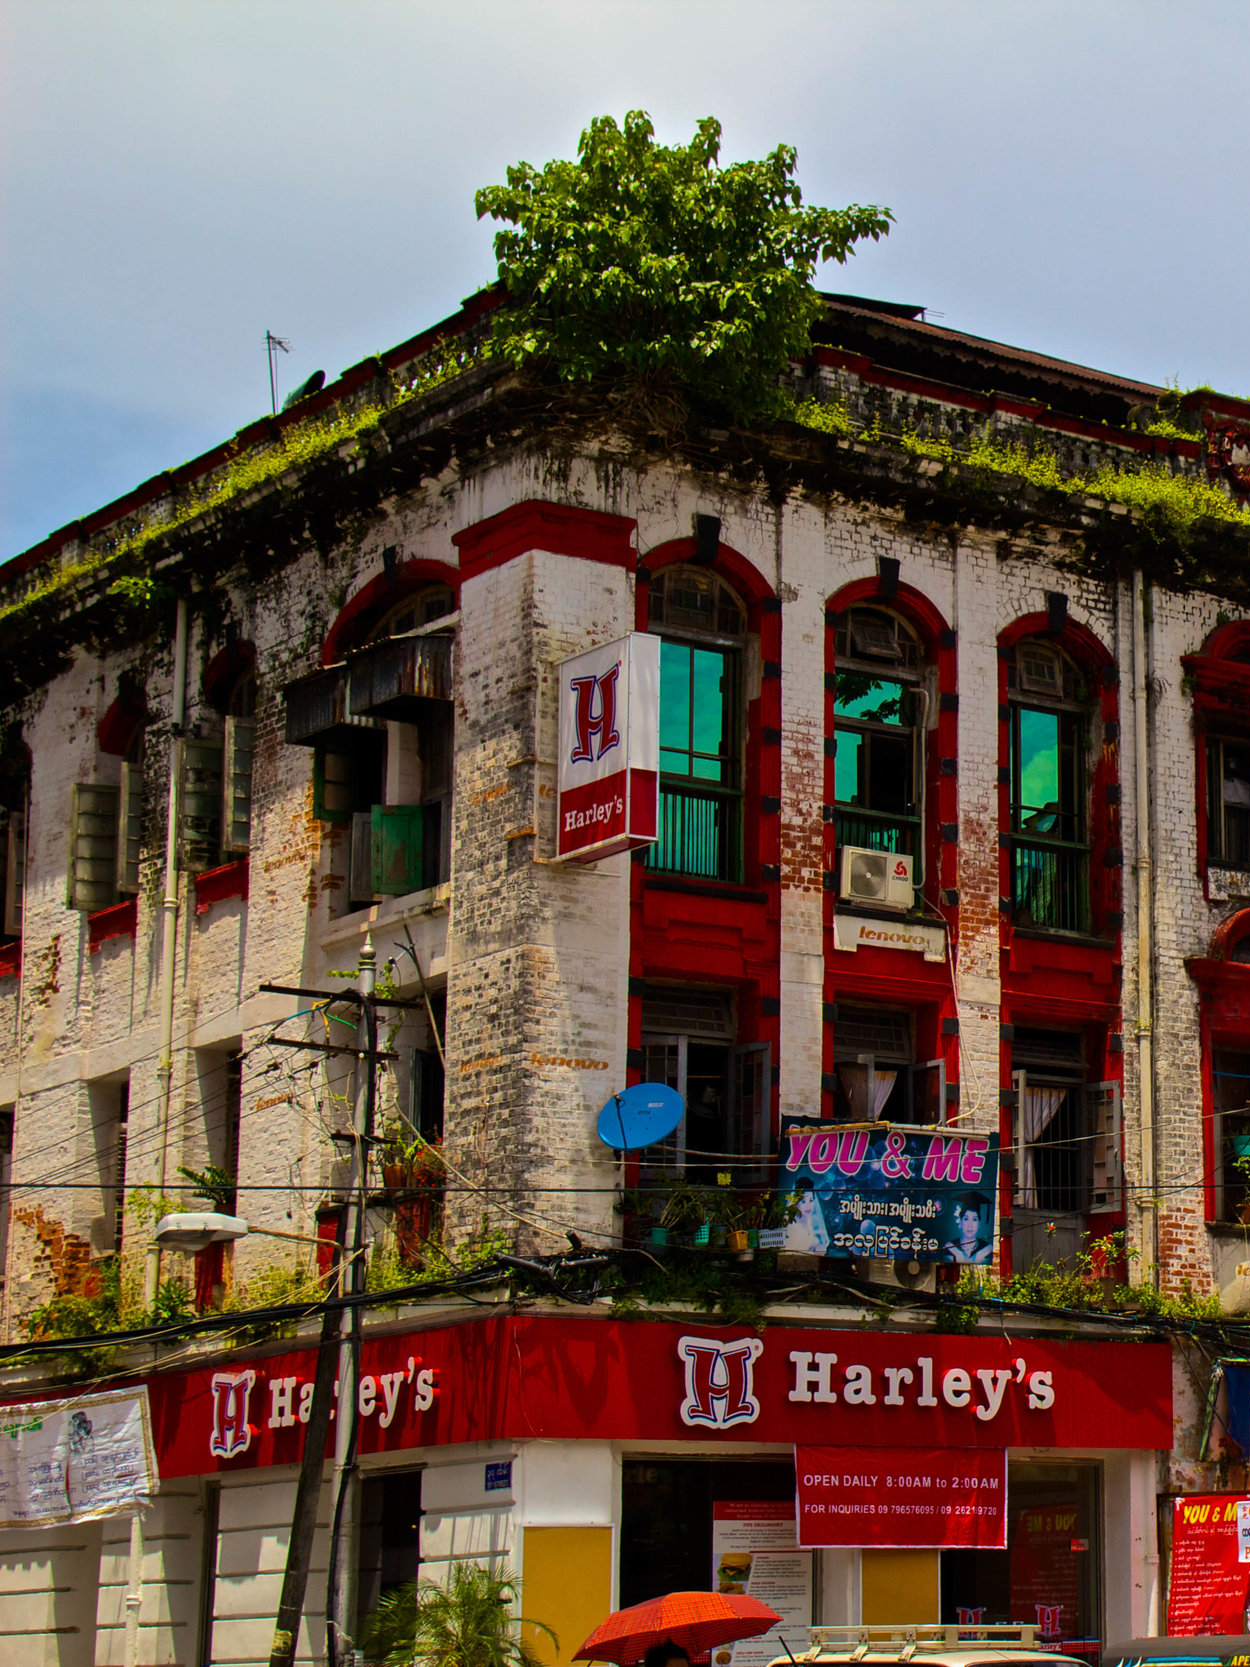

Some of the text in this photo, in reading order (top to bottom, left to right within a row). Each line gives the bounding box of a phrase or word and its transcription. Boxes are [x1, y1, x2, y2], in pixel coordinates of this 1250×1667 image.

[564, 796, 623, 832] Harley's
[858, 925, 925, 945] lenovo
[785, 1124, 990, 1184] YOU & ME
[268, 1356, 433, 1429] Haey's
[788, 1351, 1056, 1421] Harley's
[803, 1474, 839, 1487] OPEN
[843, 1475, 878, 1487] DAILY
[886, 1476, 931, 1488] 8:00AM
[936, 1477, 947, 1488] to
[804, 1505, 825, 1514] FOR
[829, 1504, 875, 1514] INQUIRIES
[878, 1505, 888, 1514] 09
[941, 1506, 951, 1515] 09
[1183, 1503, 1237, 1525] YOU & M
